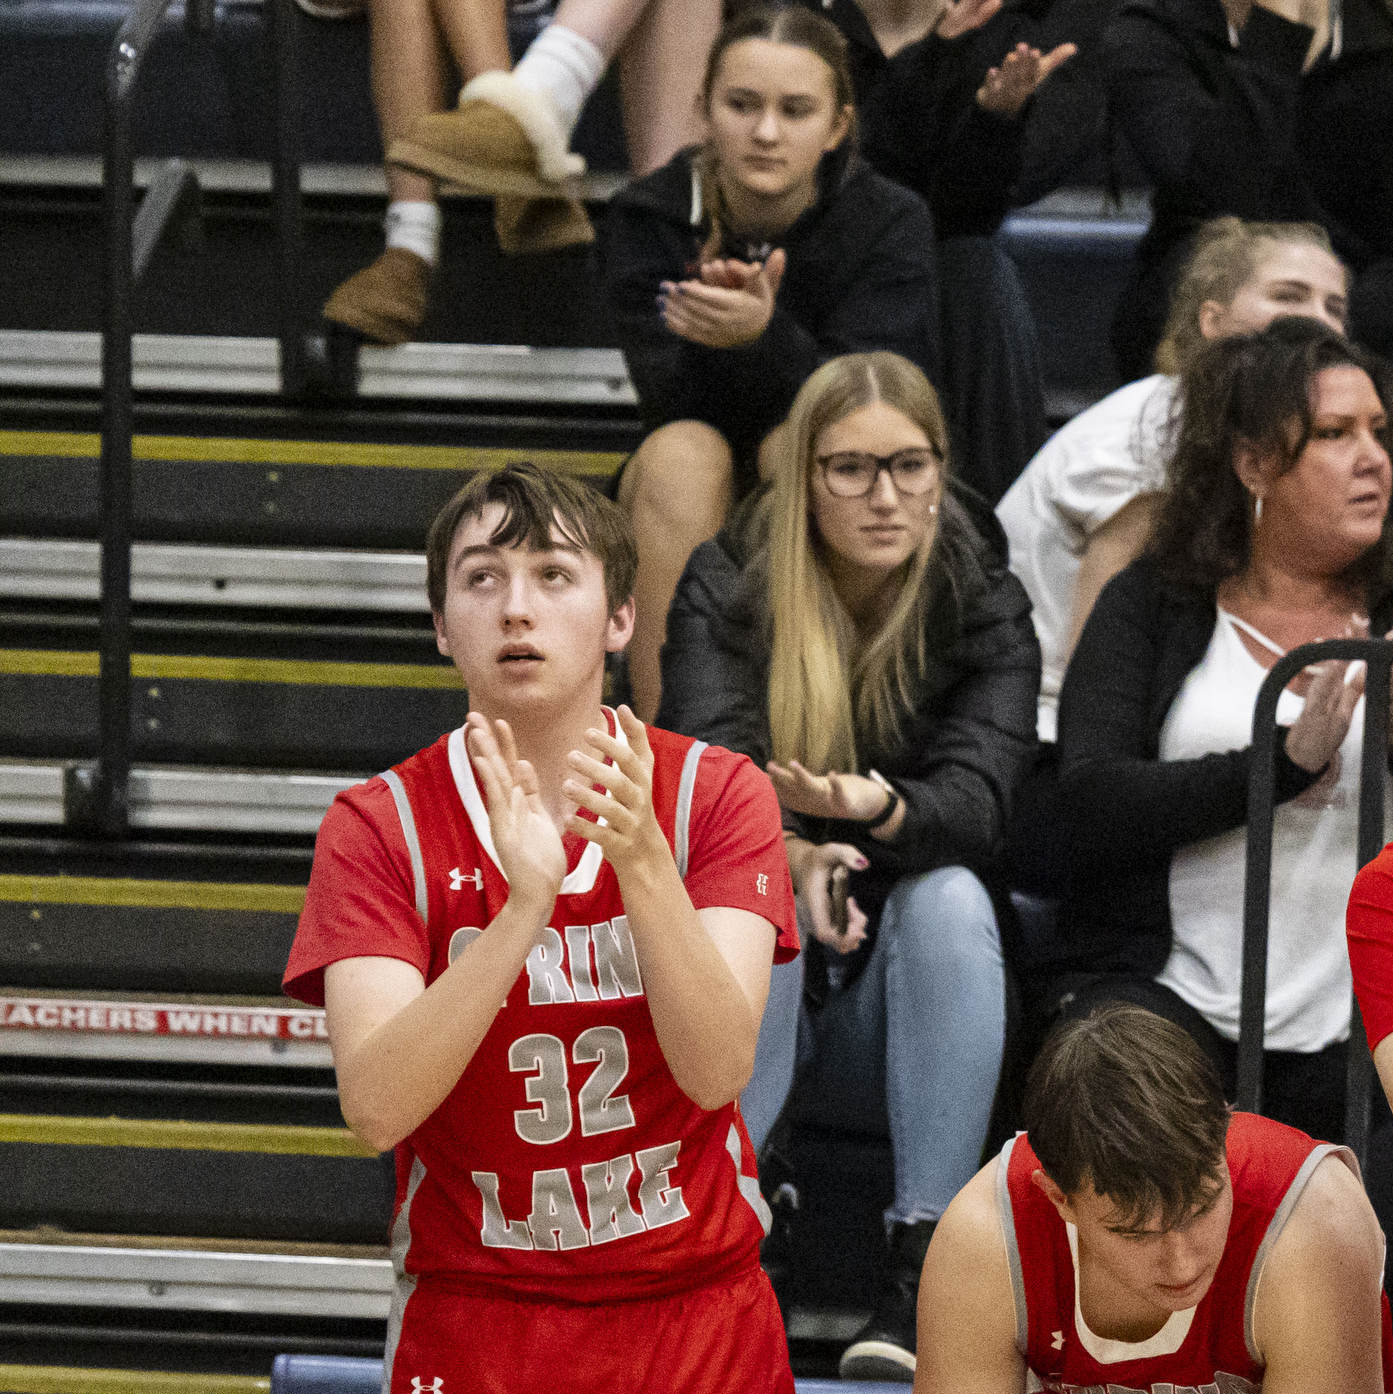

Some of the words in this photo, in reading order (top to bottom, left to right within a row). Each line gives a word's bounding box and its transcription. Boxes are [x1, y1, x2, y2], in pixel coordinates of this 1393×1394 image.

[0, 1001, 156, 1032] ACHERS
[165, 1010, 279, 1037] WHEN
[508, 1025, 636, 1145] 32
[470, 1140, 691, 1252] LAKE
